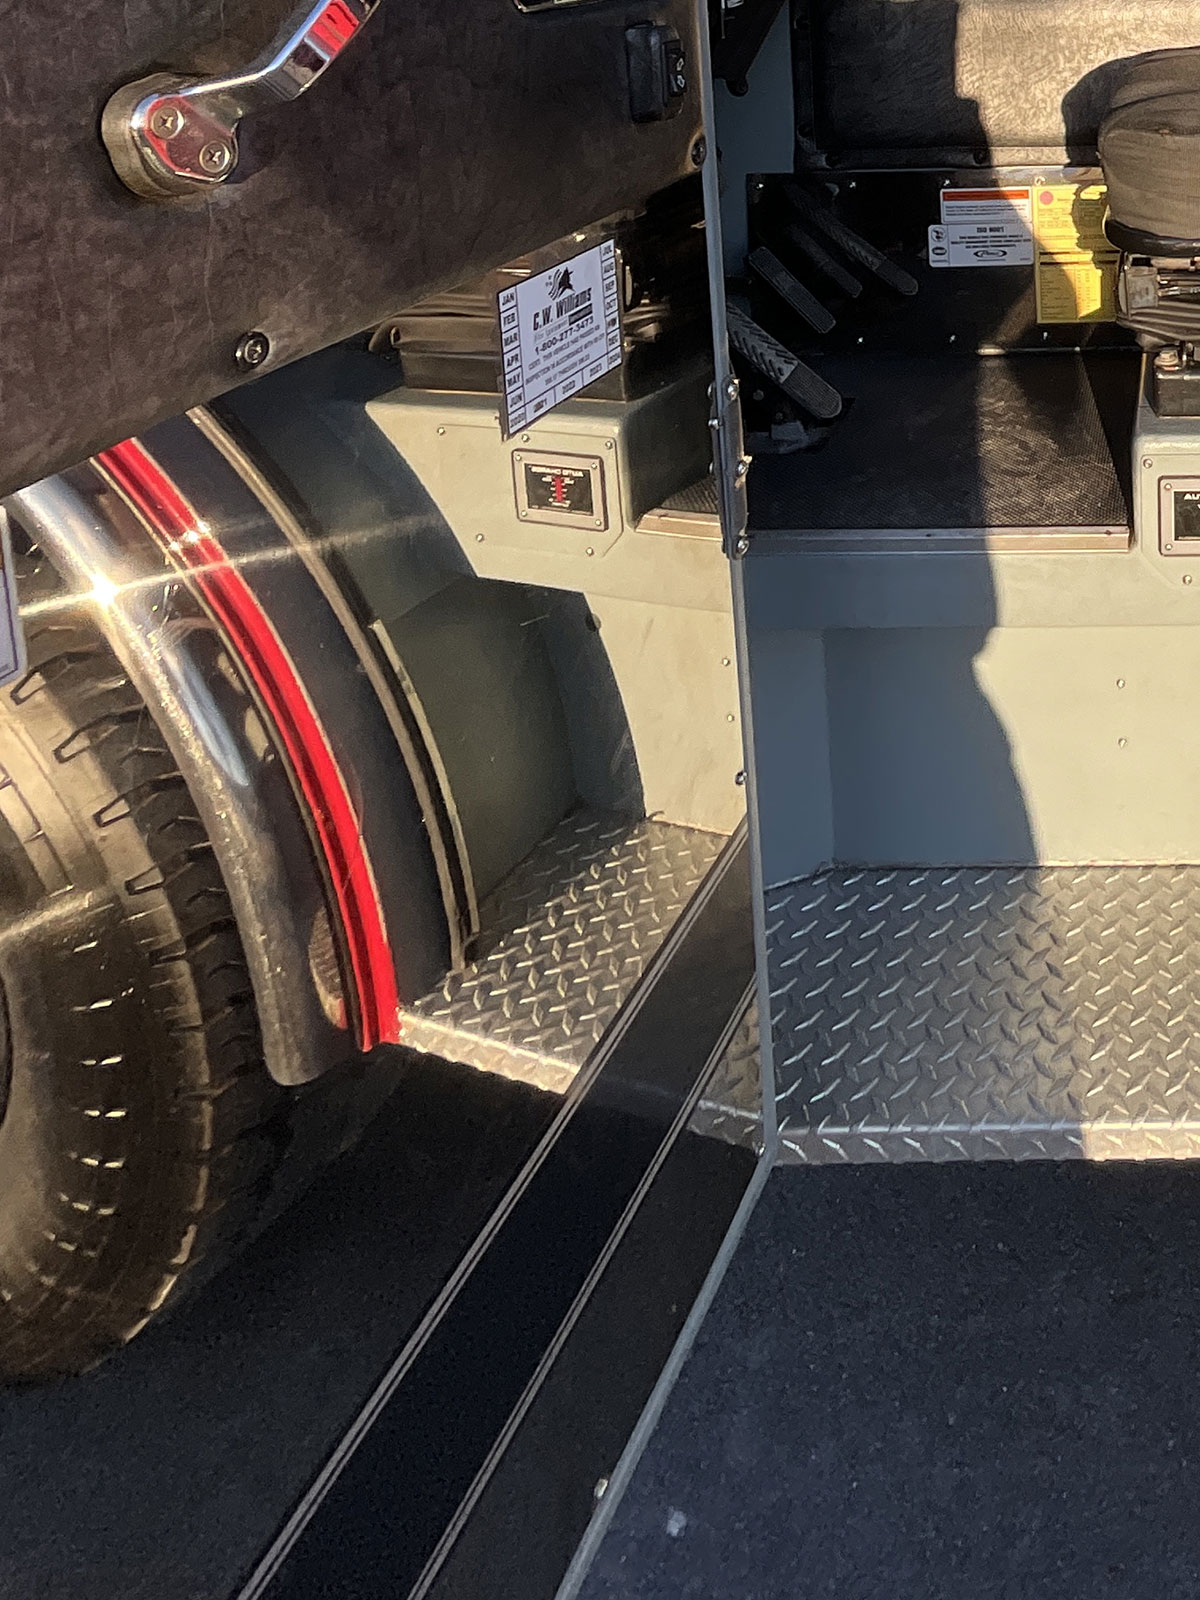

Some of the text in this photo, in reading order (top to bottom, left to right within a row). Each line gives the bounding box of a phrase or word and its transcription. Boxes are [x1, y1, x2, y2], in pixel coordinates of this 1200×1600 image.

[502, 292, 515, 306] JAN
[533, 305, 553, 331] C.W.
[556, 287, 592, 318] Williams
[504, 333, 518, 347] MAR
[507, 353, 519, 368] APR
